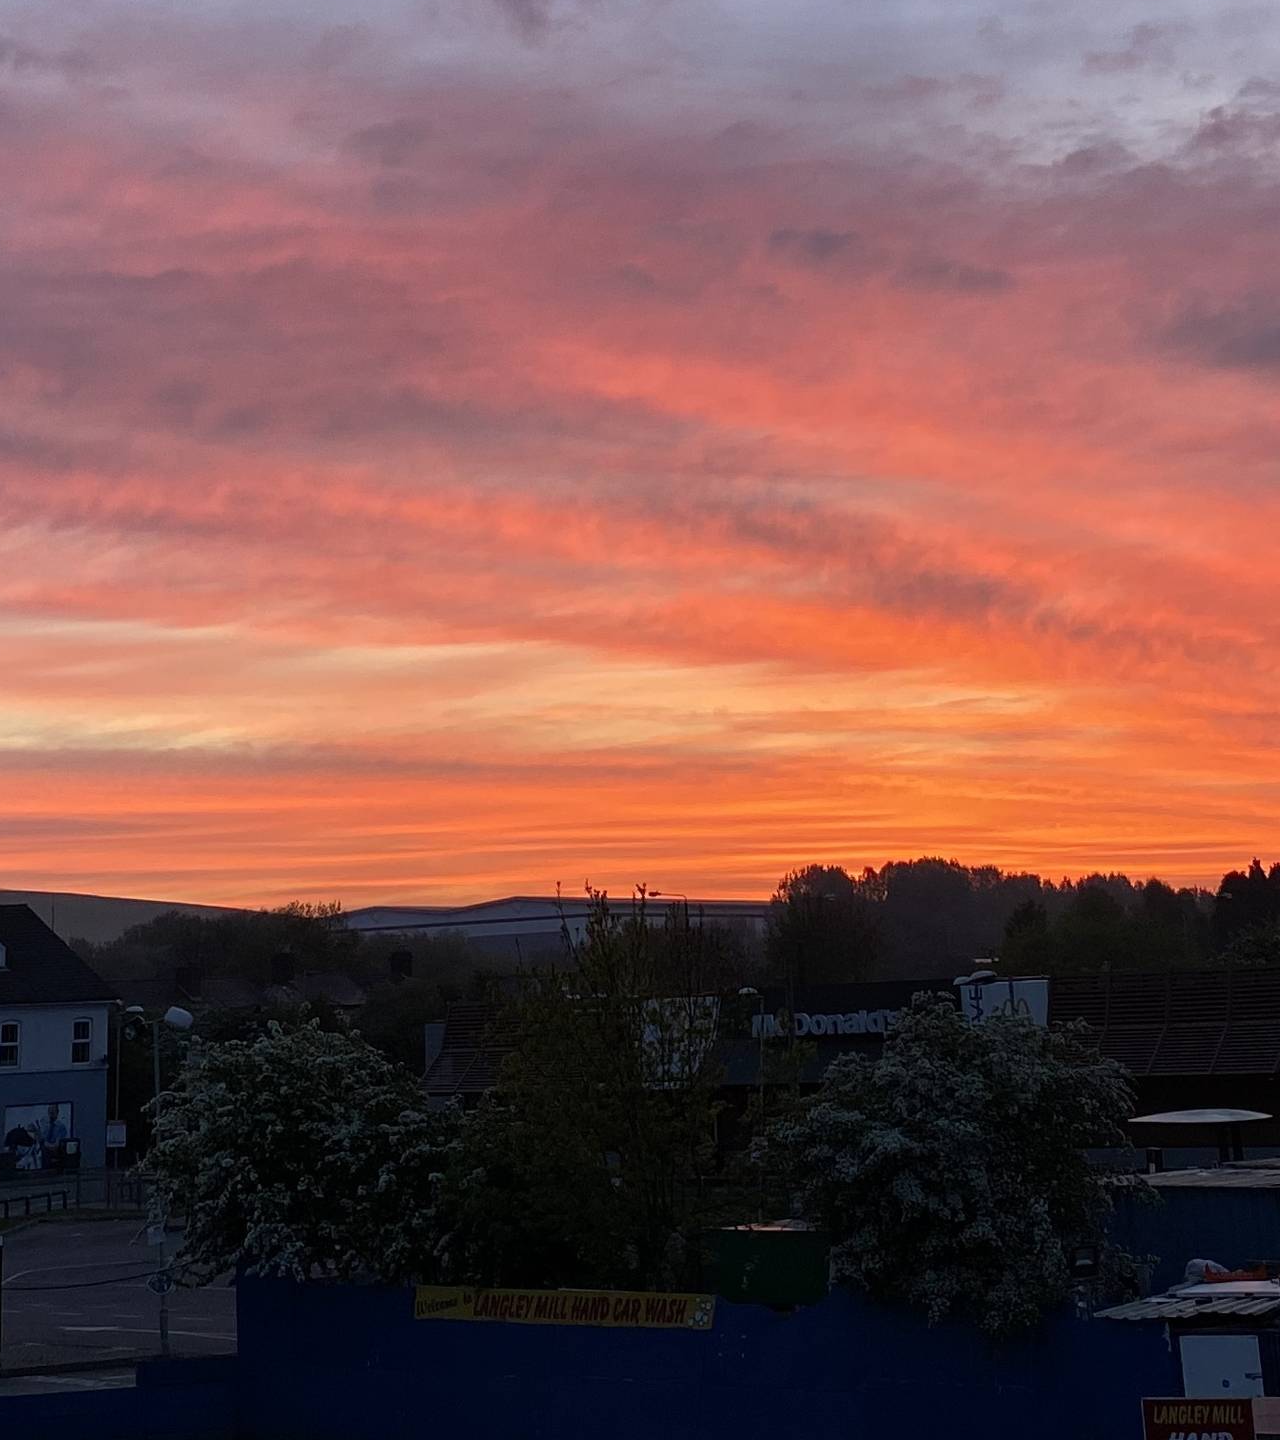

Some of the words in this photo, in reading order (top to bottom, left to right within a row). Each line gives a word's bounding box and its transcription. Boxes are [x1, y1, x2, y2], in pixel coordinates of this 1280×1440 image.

[472, 1294, 531, 1320] LANGLEY
[533, 1295, 569, 1321] MILL
[570, 1295, 610, 1322] HAND
[613, 1296, 641, 1323] CAR
[645, 1297, 688, 1324] WASH
[1153, 1405, 1210, 1425] LANGLEY
[1212, 1405, 1245, 1425] MILL
